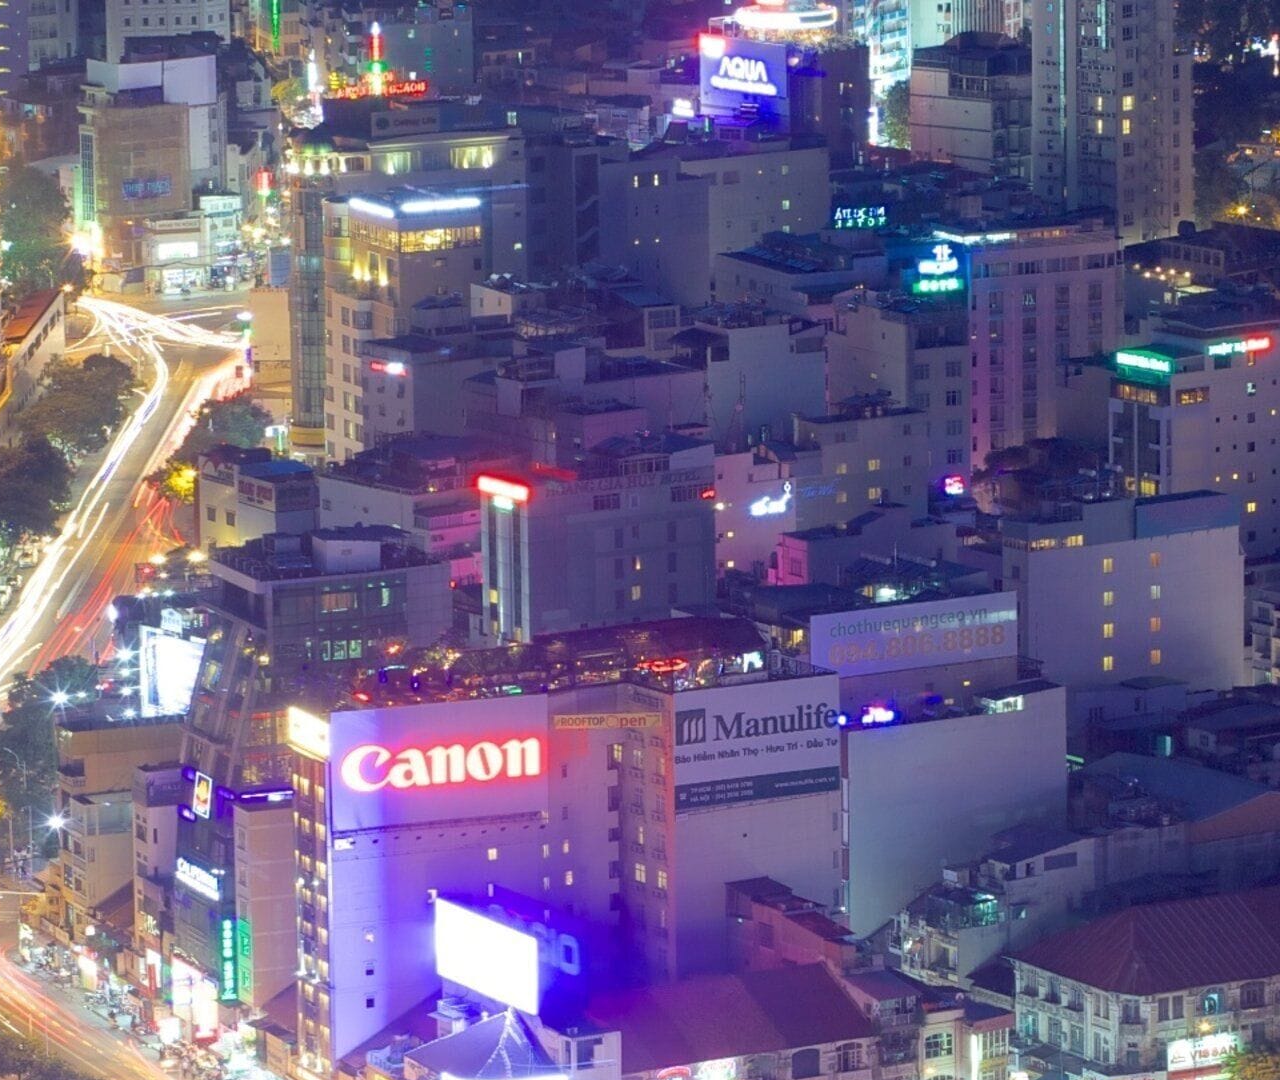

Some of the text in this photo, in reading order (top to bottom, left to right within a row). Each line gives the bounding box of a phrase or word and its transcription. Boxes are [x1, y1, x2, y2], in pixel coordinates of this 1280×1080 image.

[719, 55, 768, 82] AQUA
[712, 702, 839, 742] Manulife
[340, 737, 541, 793] Canon
